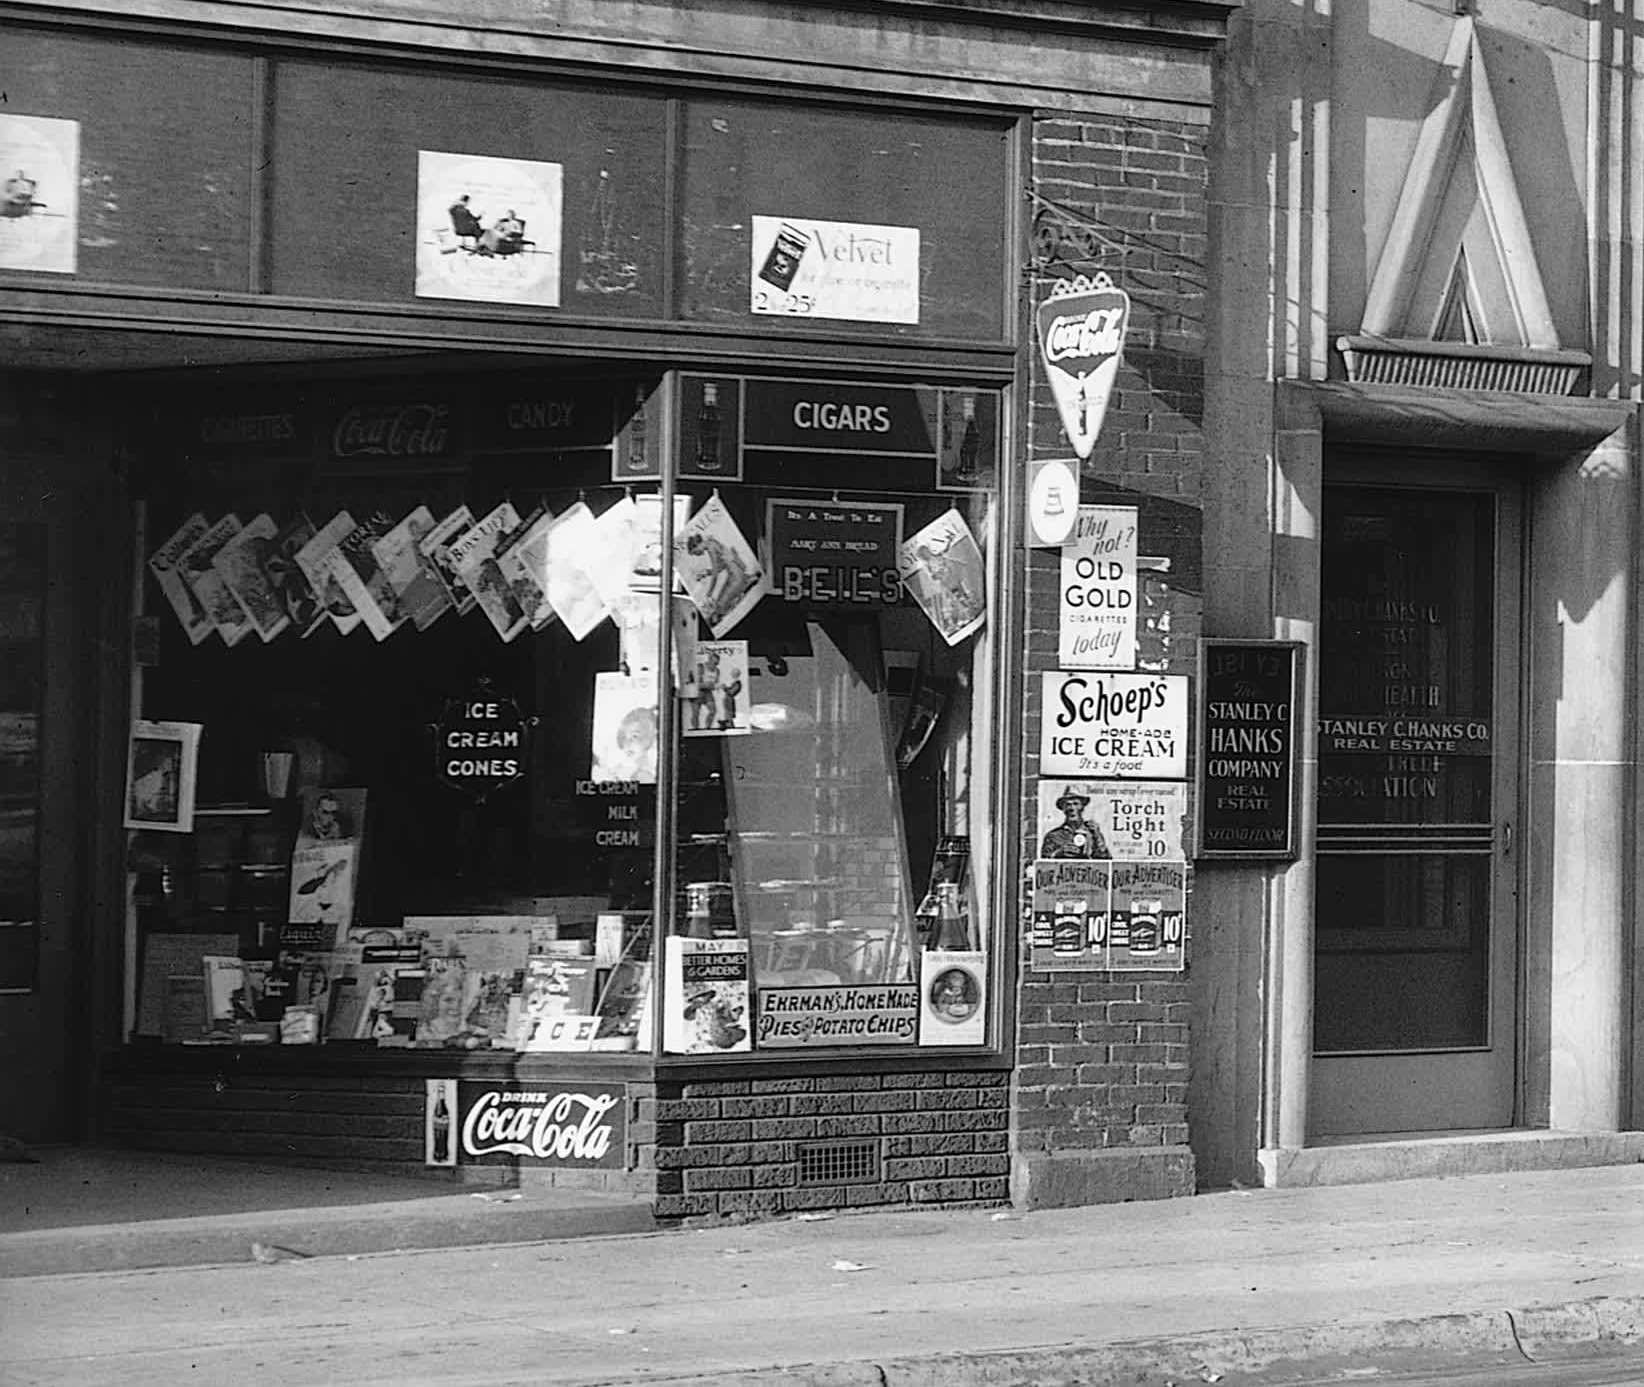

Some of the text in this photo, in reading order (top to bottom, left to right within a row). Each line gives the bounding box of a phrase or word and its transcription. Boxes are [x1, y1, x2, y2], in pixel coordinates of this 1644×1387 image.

[814, 229, 892, 265] Velvet
[508, 402, 576, 429] CANDY
[794, 401, 891, 433] CIGARS
[1075, 557, 1124, 581] OLD
[1065, 584, 1132, 609] GOLD
[1069, 615, 1128, 624] CIGARETTES
[1072, 627, 1122, 658] today
[464, 702, 500, 719] ICE
[1056, 677, 1168, 728] Schoep's
[1208, 701, 1275, 721] STANLEY
[447, 731, 519, 748] CREAM
[1407, 721, 1464, 740] HANKS
[1466, 722, 1490, 741] CO.
[1051, 736, 1175, 758] ICE CREAM
[1210, 727, 1284, 755] HANKS
[1333, 737, 1457, 752] REAL ESTATE
[446, 759, 519, 776] CONES
[1112, 758, 1144, 774] food
[1208, 759, 1283, 779] COMPANY
[575, 780, 640, 795] ICE CREAM
[1226, 784, 1268, 798] REAL
[608, 805, 639, 820] MILK
[1110, 798, 1166, 816] Torch
[1217, 797, 1272, 811] ESTATE
[1112, 816, 1166, 840] Light
[595, 830, 640, 846] CREAM
[1147, 839, 1167, 858] 10
[694, 941, 725, 953] MAY
[713, 953, 747, 966] HOMES
[697, 964, 741, 977] GARDENS
[887, 989, 918, 1010] MADE
[759, 1014, 802, 1041] PIES
[813, 1016, 868, 1036] POTATO
[866, 1014, 917, 1038] CHIPS
[501, 1092, 547, 1104] DRINK
[462, 1090, 618, 1160] Coca-Cola
